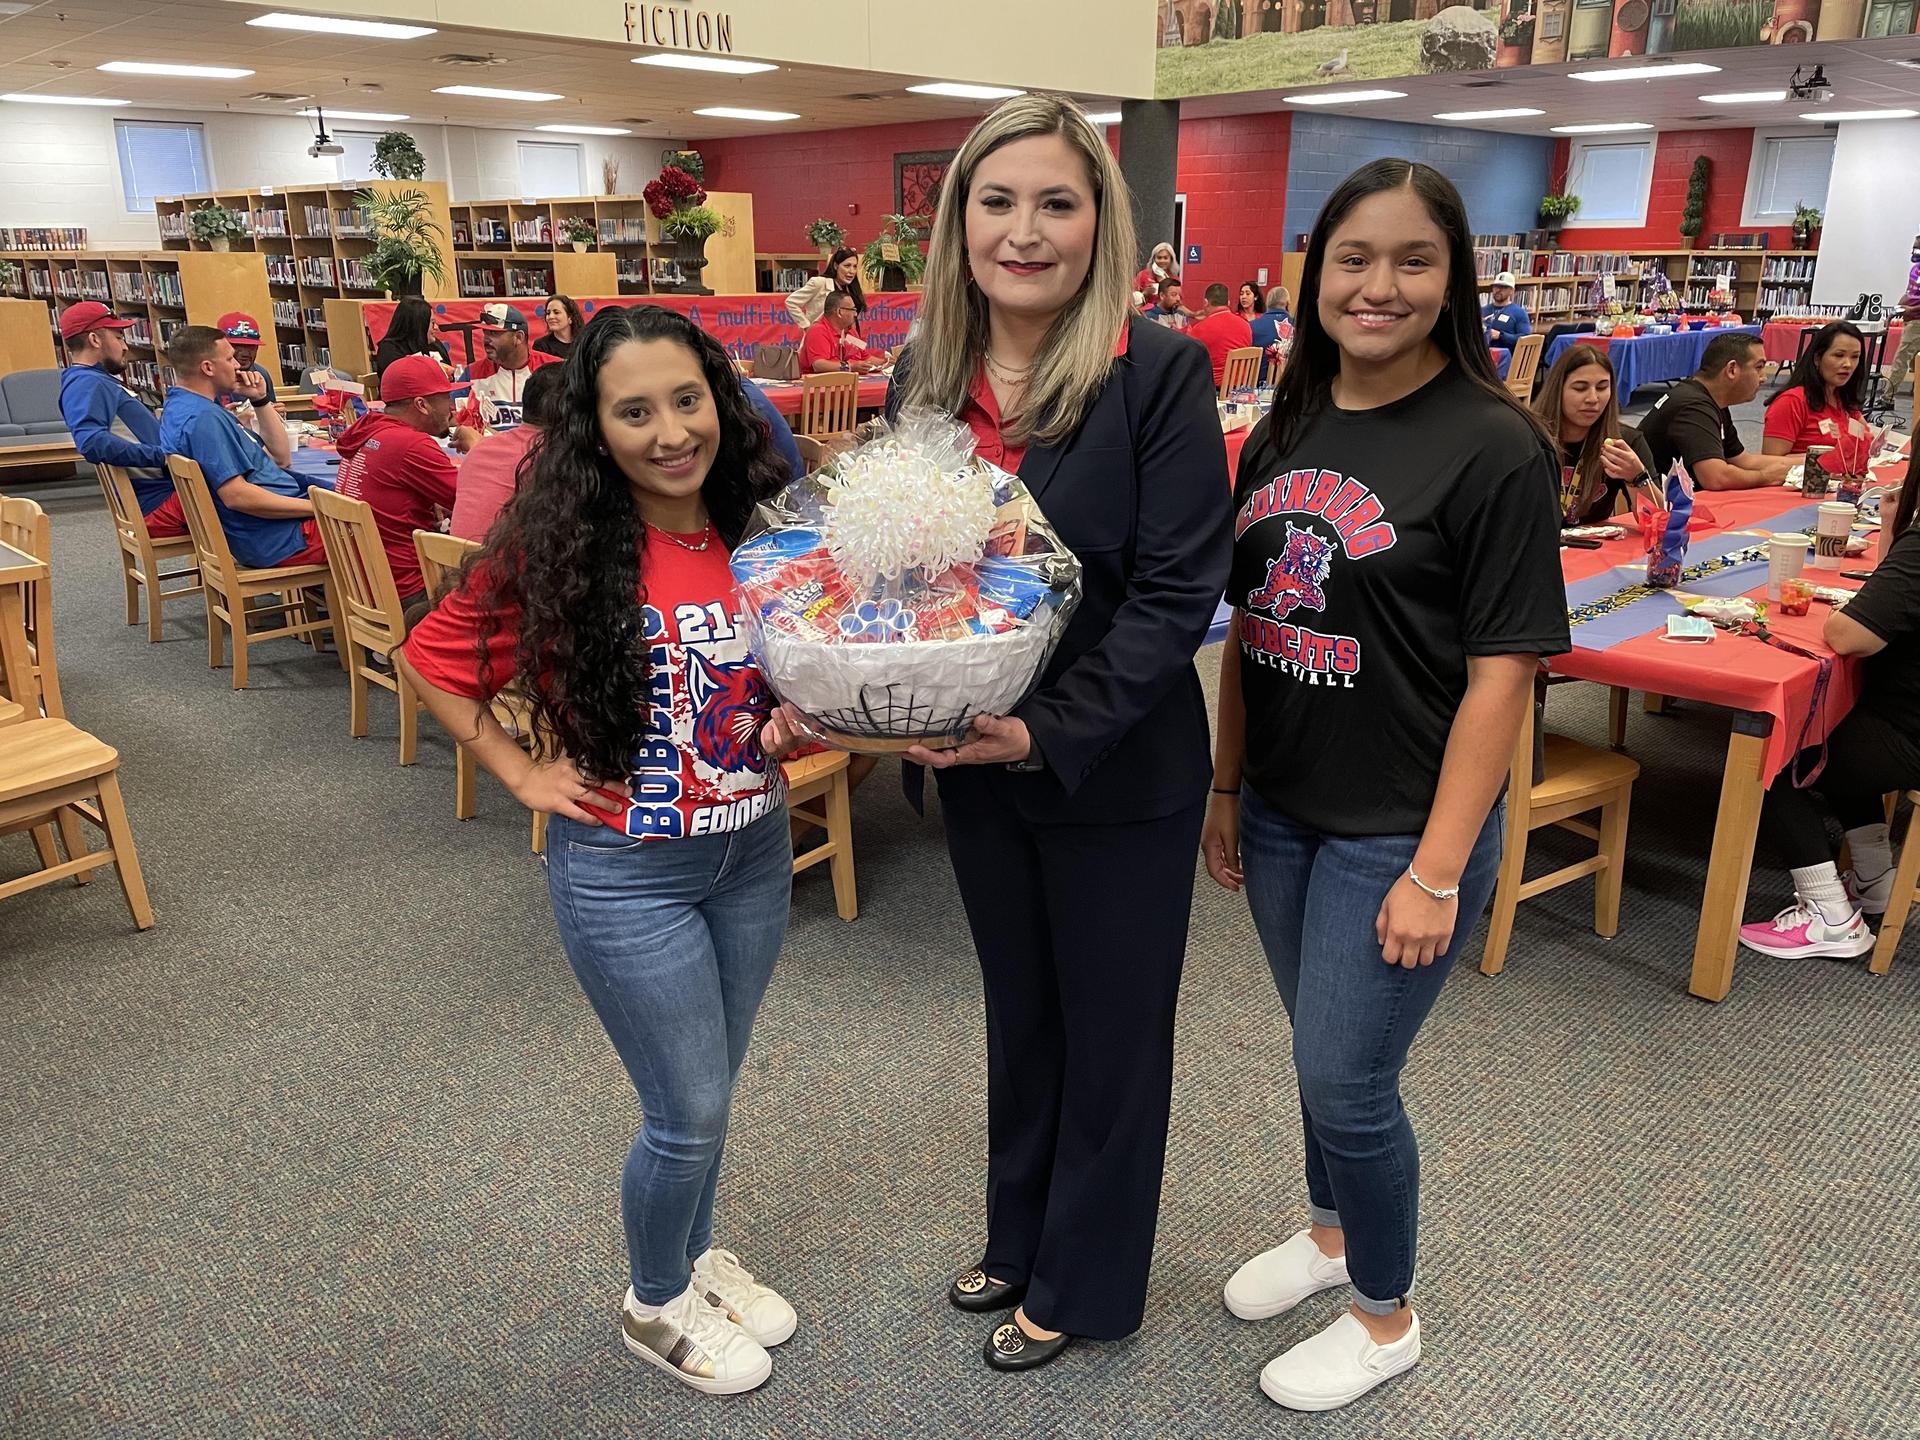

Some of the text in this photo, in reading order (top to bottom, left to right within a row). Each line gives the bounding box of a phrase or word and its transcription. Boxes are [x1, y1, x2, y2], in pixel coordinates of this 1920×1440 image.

[624, 2, 733, 52] FICTION
[689, 304, 703, 326] A
[1235, 468, 1397, 560] EDINBURG
[1239, 606, 1361, 675] BOBCATS
